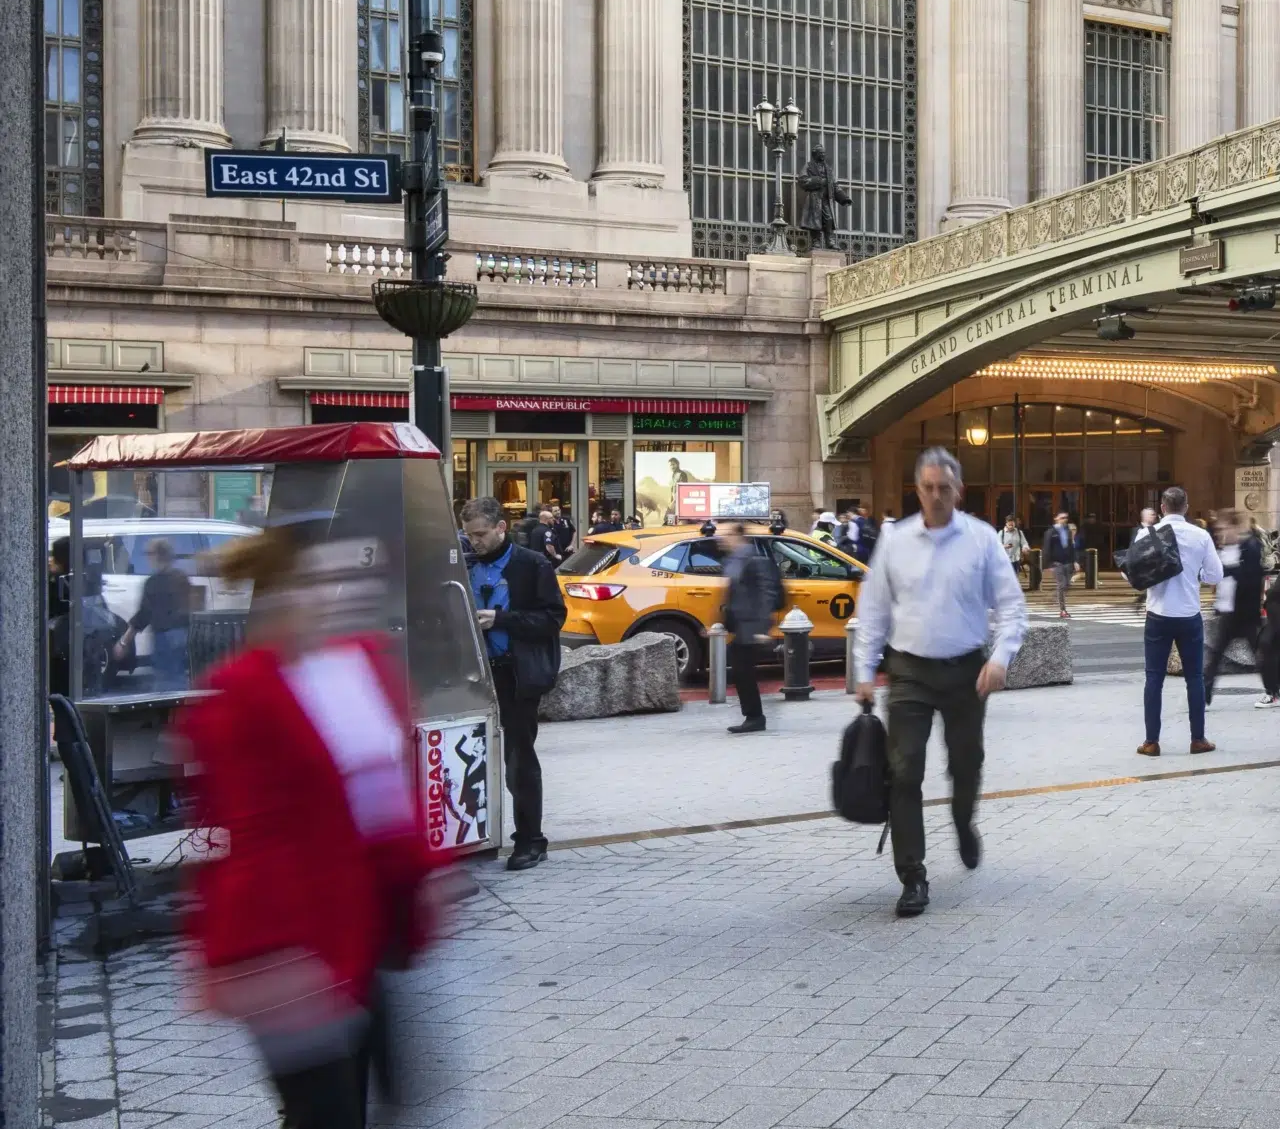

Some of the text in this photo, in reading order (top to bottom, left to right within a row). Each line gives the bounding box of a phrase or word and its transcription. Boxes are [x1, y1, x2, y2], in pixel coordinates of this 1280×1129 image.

[220, 164, 380, 188] East 42nd St
[911, 264, 1143, 374] GRAND CENTRAL TERMINAL
[496, 400, 591, 411] BANANA REPUBLIC
[428, 729, 444, 848] CHICAGO
